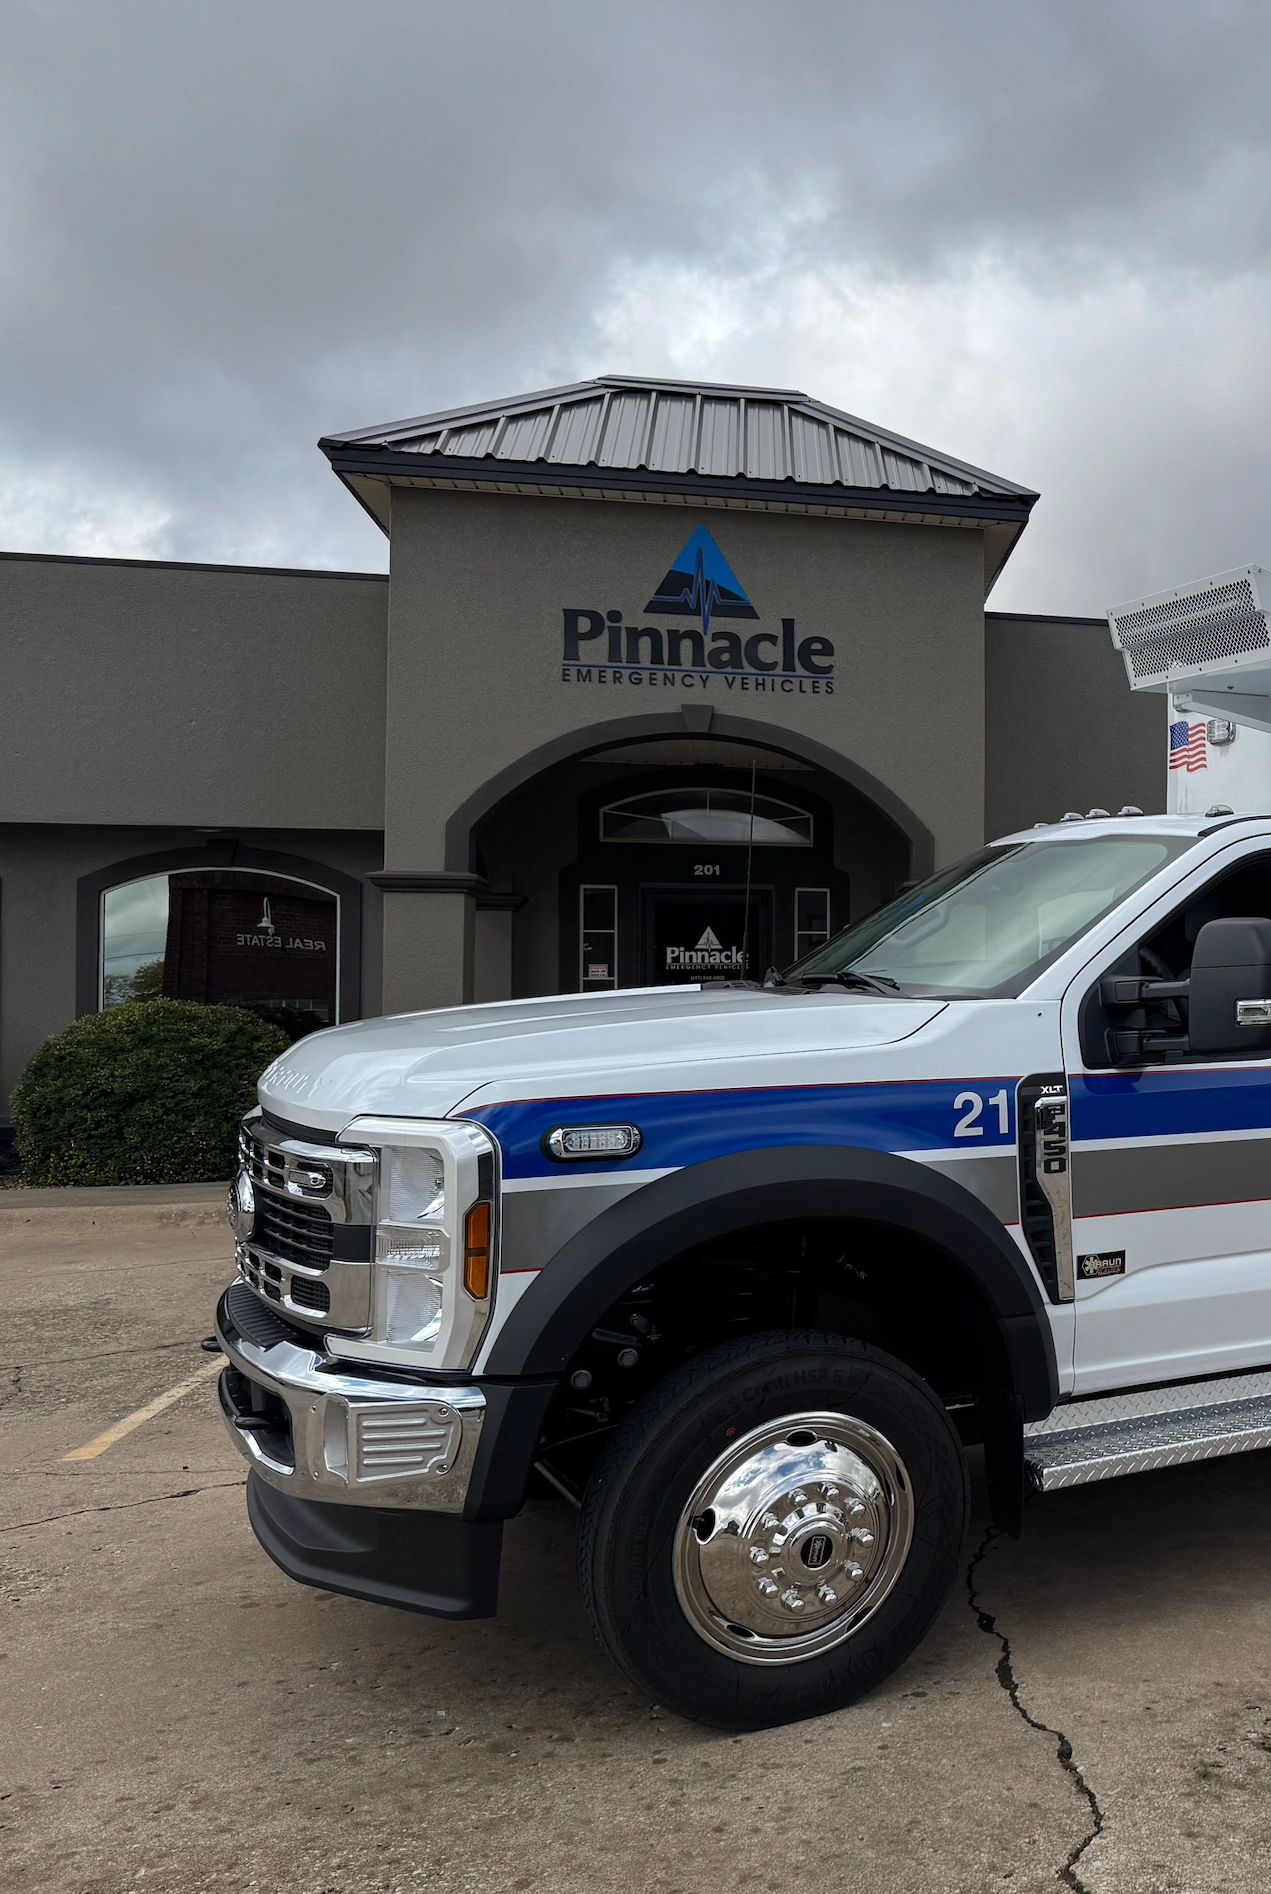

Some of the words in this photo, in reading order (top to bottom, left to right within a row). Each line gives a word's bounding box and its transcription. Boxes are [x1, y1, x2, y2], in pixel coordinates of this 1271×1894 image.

[562, 608, 835, 674] Pinnacle
[561, 668, 710, 689] EMERGENCY
[725, 675, 835, 694] VEHICLES
[694, 864, 720, 875] 201
[1040, 1085, 1064, 1094] XLT
[953, 1089, 1009, 1138] 21
